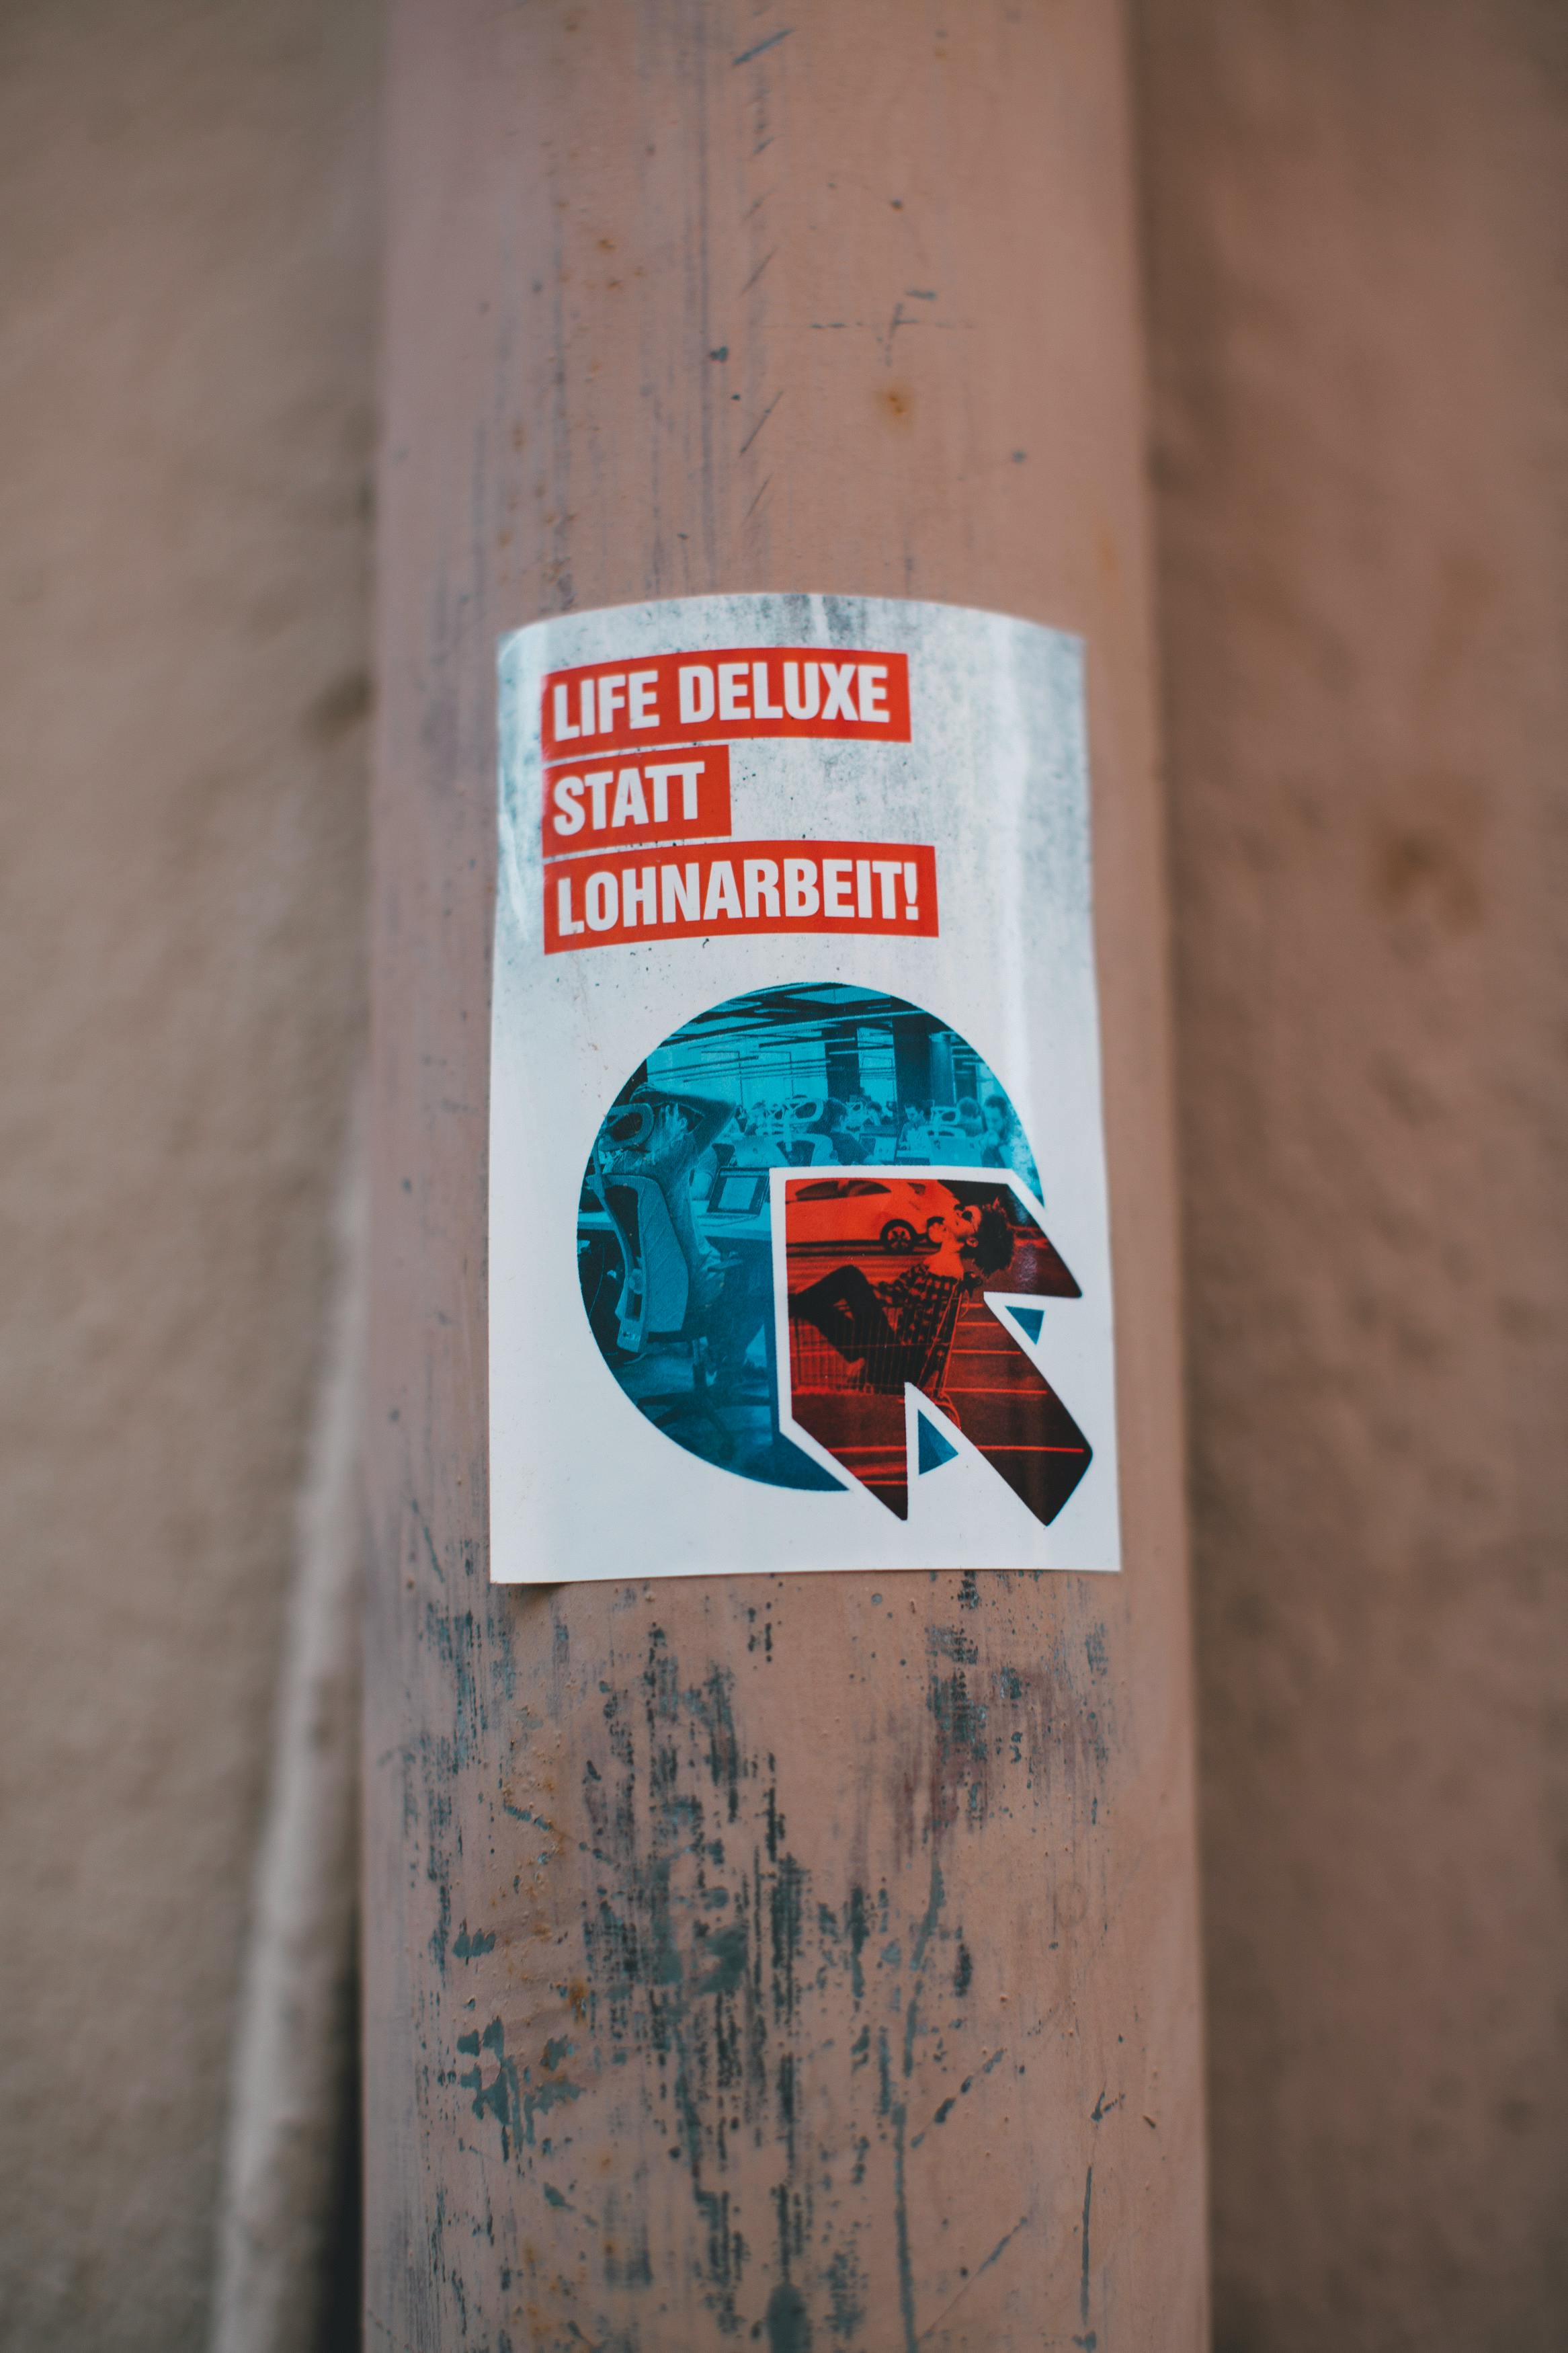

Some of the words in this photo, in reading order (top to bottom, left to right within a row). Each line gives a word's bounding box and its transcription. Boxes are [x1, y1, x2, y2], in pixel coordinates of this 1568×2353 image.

[554, 670, 659, 742] LIFE
[678, 662, 891, 724] DELUXE
[552, 761, 705, 836] STATT
[556, 859, 919, 936] LOHNARBEIT!
